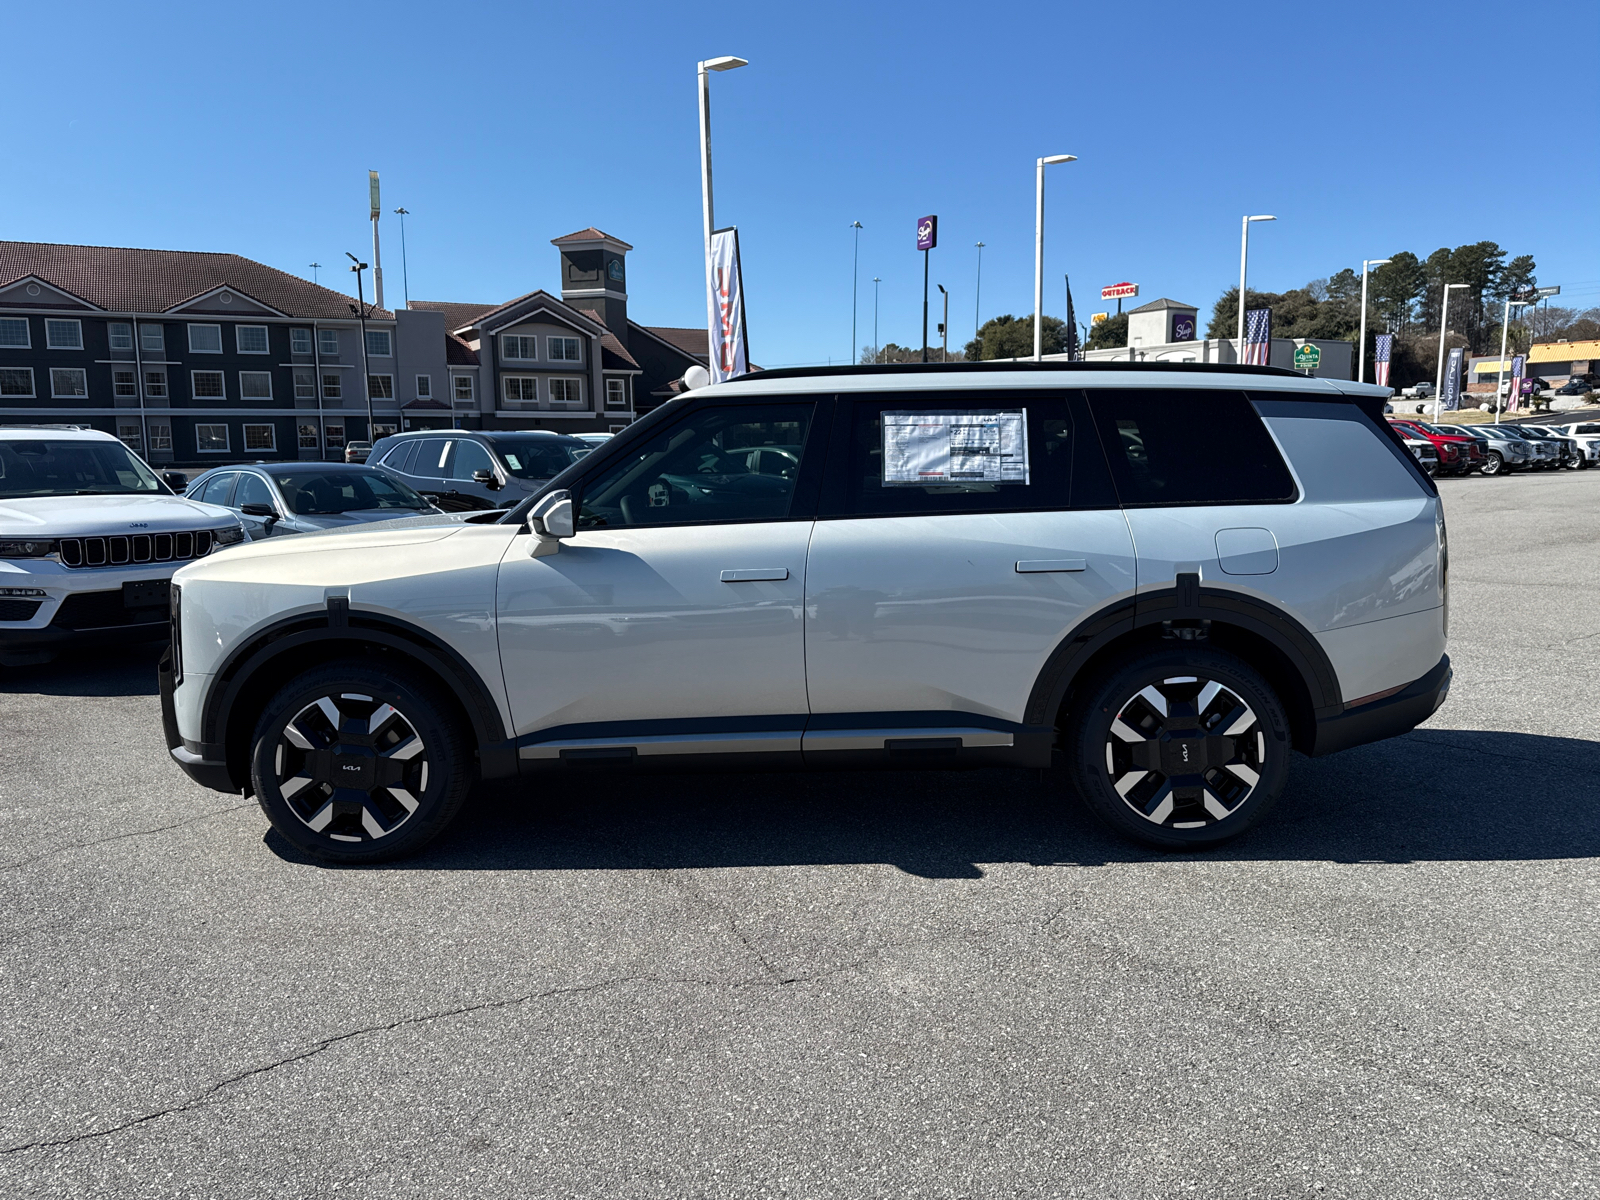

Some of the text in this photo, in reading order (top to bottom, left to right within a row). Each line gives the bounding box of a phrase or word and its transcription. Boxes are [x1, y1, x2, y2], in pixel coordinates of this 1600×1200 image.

[1102, 286, 1135, 297] OUTBACK
[1176, 324, 1191, 338] Sleep
[287, 675, 355, 701] SCORPION
[1209, 661, 1271, 705] SCORPION
[1181, 743, 1189, 762] KIA
[342, 764, 361, 772] KIA
